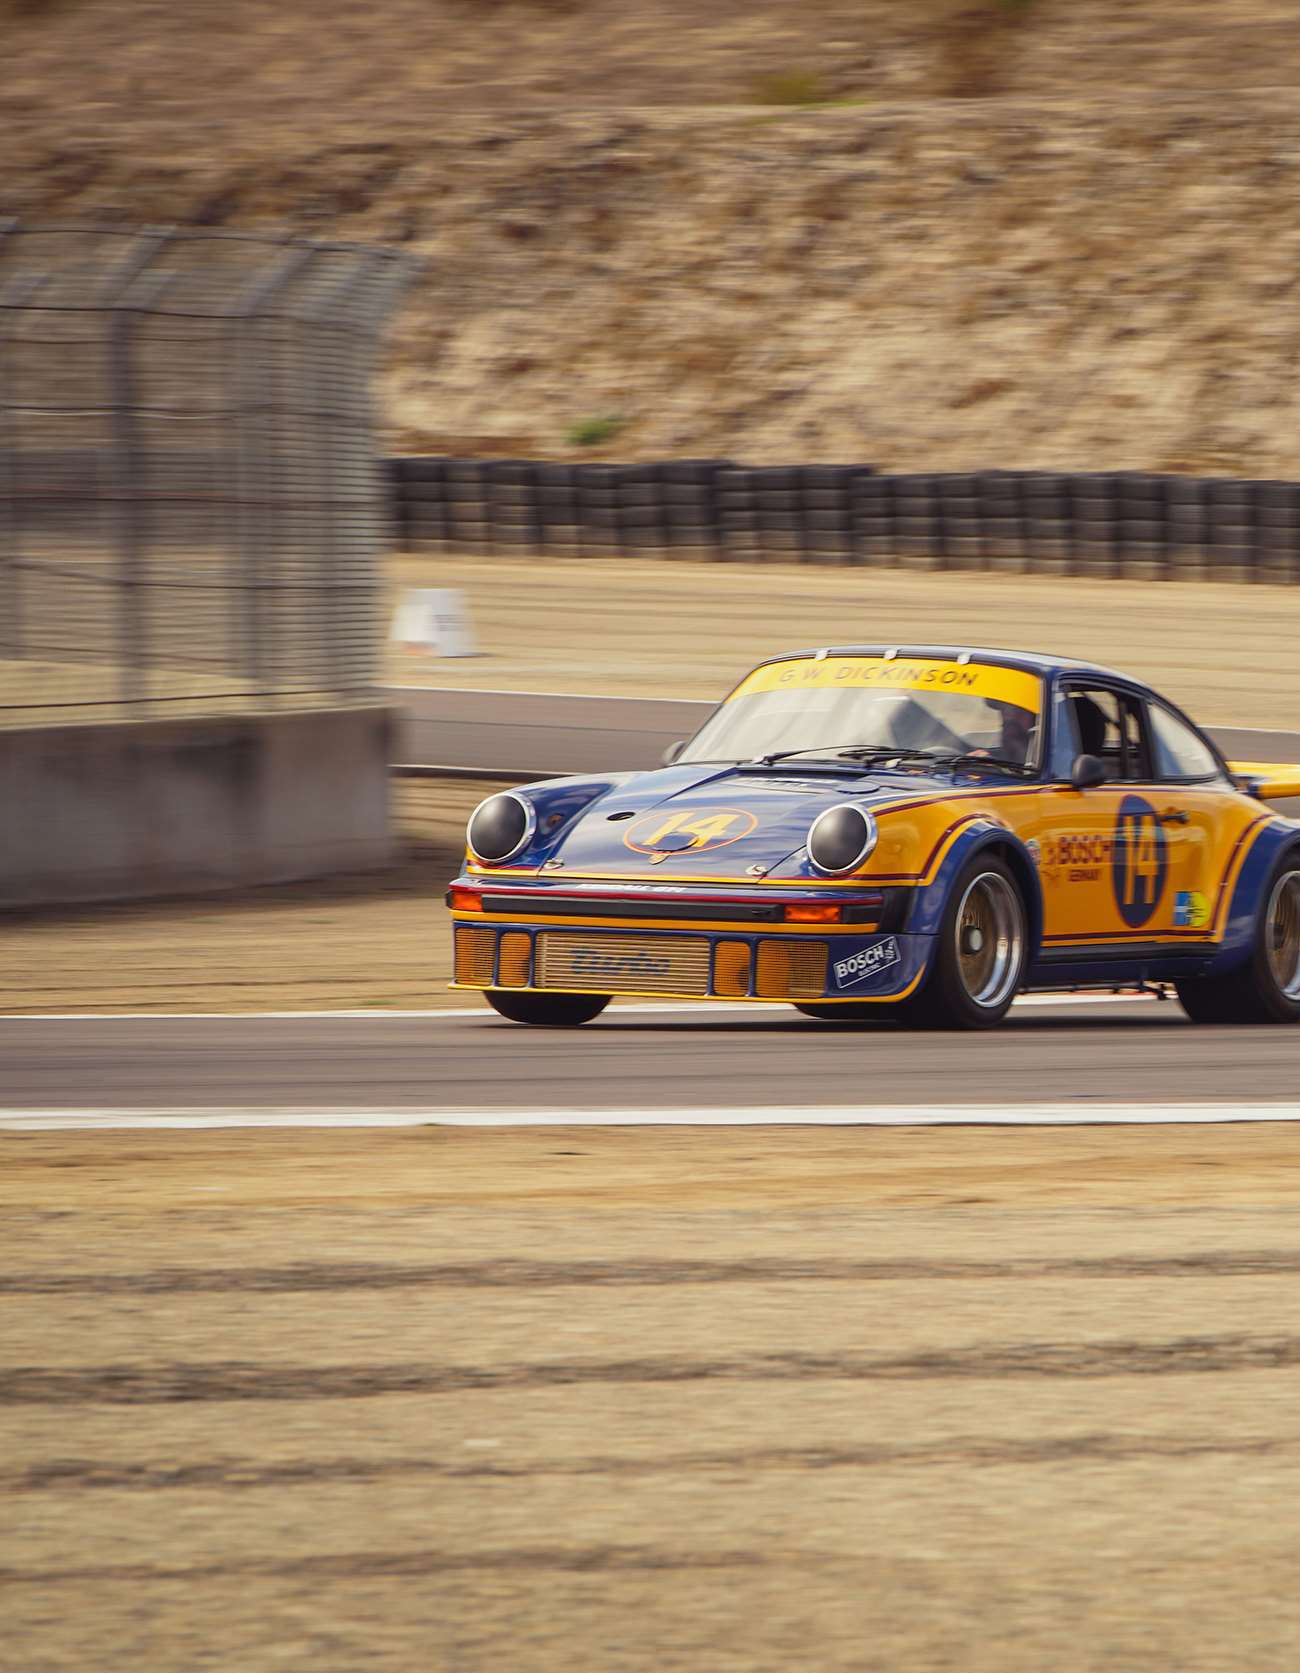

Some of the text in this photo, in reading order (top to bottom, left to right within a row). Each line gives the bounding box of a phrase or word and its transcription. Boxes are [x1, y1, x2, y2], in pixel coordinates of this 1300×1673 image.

[835, 665, 979, 687] DICKINSON
[641, 811, 741, 848] 14
[1122, 815, 1159, 905] 14
[836, 945, 885, 978] BOSCH
